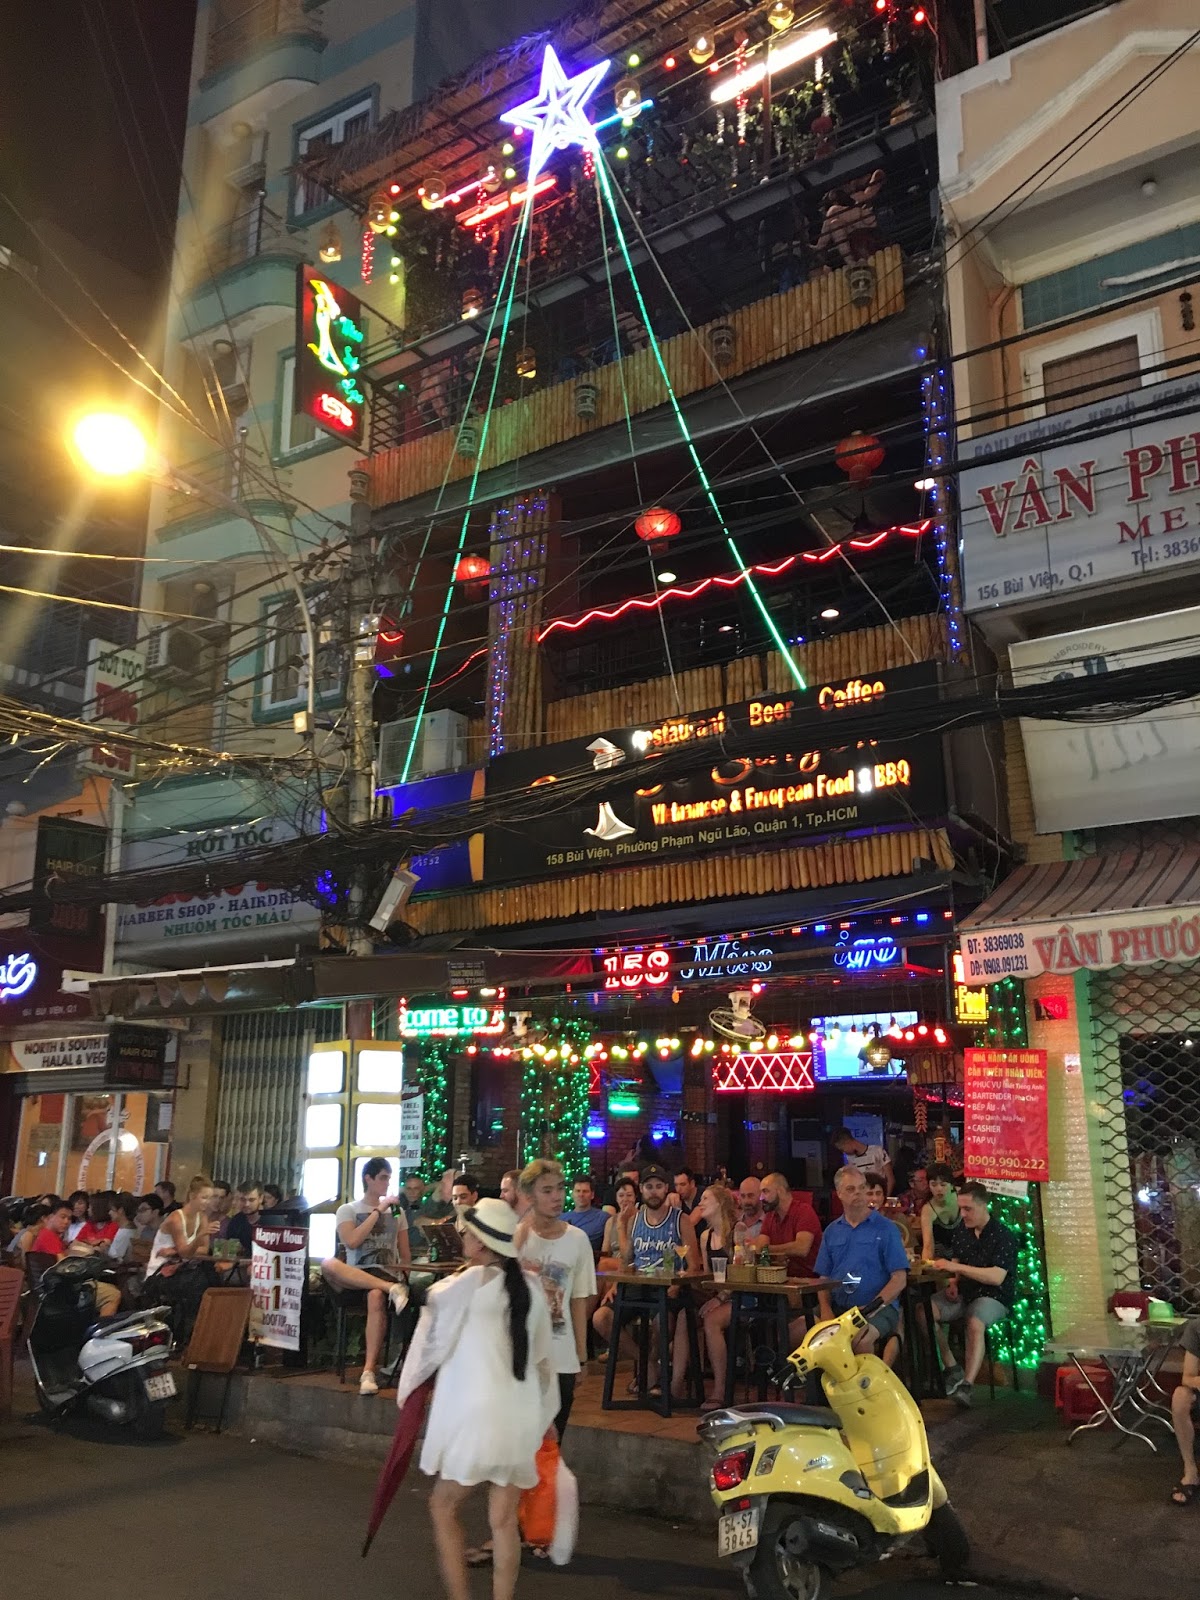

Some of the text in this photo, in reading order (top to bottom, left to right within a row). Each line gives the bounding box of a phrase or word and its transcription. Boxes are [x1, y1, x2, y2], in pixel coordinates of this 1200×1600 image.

[977, 458, 1096, 536] VÂN
[1121, 430, 1200, 504] PH
[1163, 536, 1200, 559] 3836
[978, 561, 1094, 601] 156 Bùi Viện, Q.1
[750, 700, 794, 726] Beer
[819, 680, 886, 710] Coffee
[729, 789, 743, 814] &
[816, 769, 855, 799] Food
[874, 759, 911, 788] BBQ
[546, 805, 858, 866] 158 Bùi Viện, Phường Phạm Ngũ Lão, Quận 1, Tp.HCM
[178, 903, 216, 919] SHOP
[228, 892, 305, 912] HAIRDRE
[967, 932, 1025, 954] ĐT: 38369038
[1032, 923, 1102, 970] VÂN
[603, 950, 670, 988] 158
[983, 954, 1029, 975] 0908.091231
[24, 1041, 58, 1055] NORTH
[60, 1041, 66, 1053] &
[68, 1038, 101, 1052] SOUTH
[42, 1054, 74, 1067] HALAL
[76, 1054, 83, 1065] &
[972, 1091, 1012, 1101] BARTENDER
[972, 1124, 1001, 1133] CASHIER
[967, 1155, 1046, 1170] 0909.990.222
[255, 1227, 304, 1246] Happy Hour
[253, 1265, 272, 1280] GET
[272, 1254, 281, 1281] 1
[272, 1285, 281, 1311] 1
[725, 1529, 752, 1551] 3845
